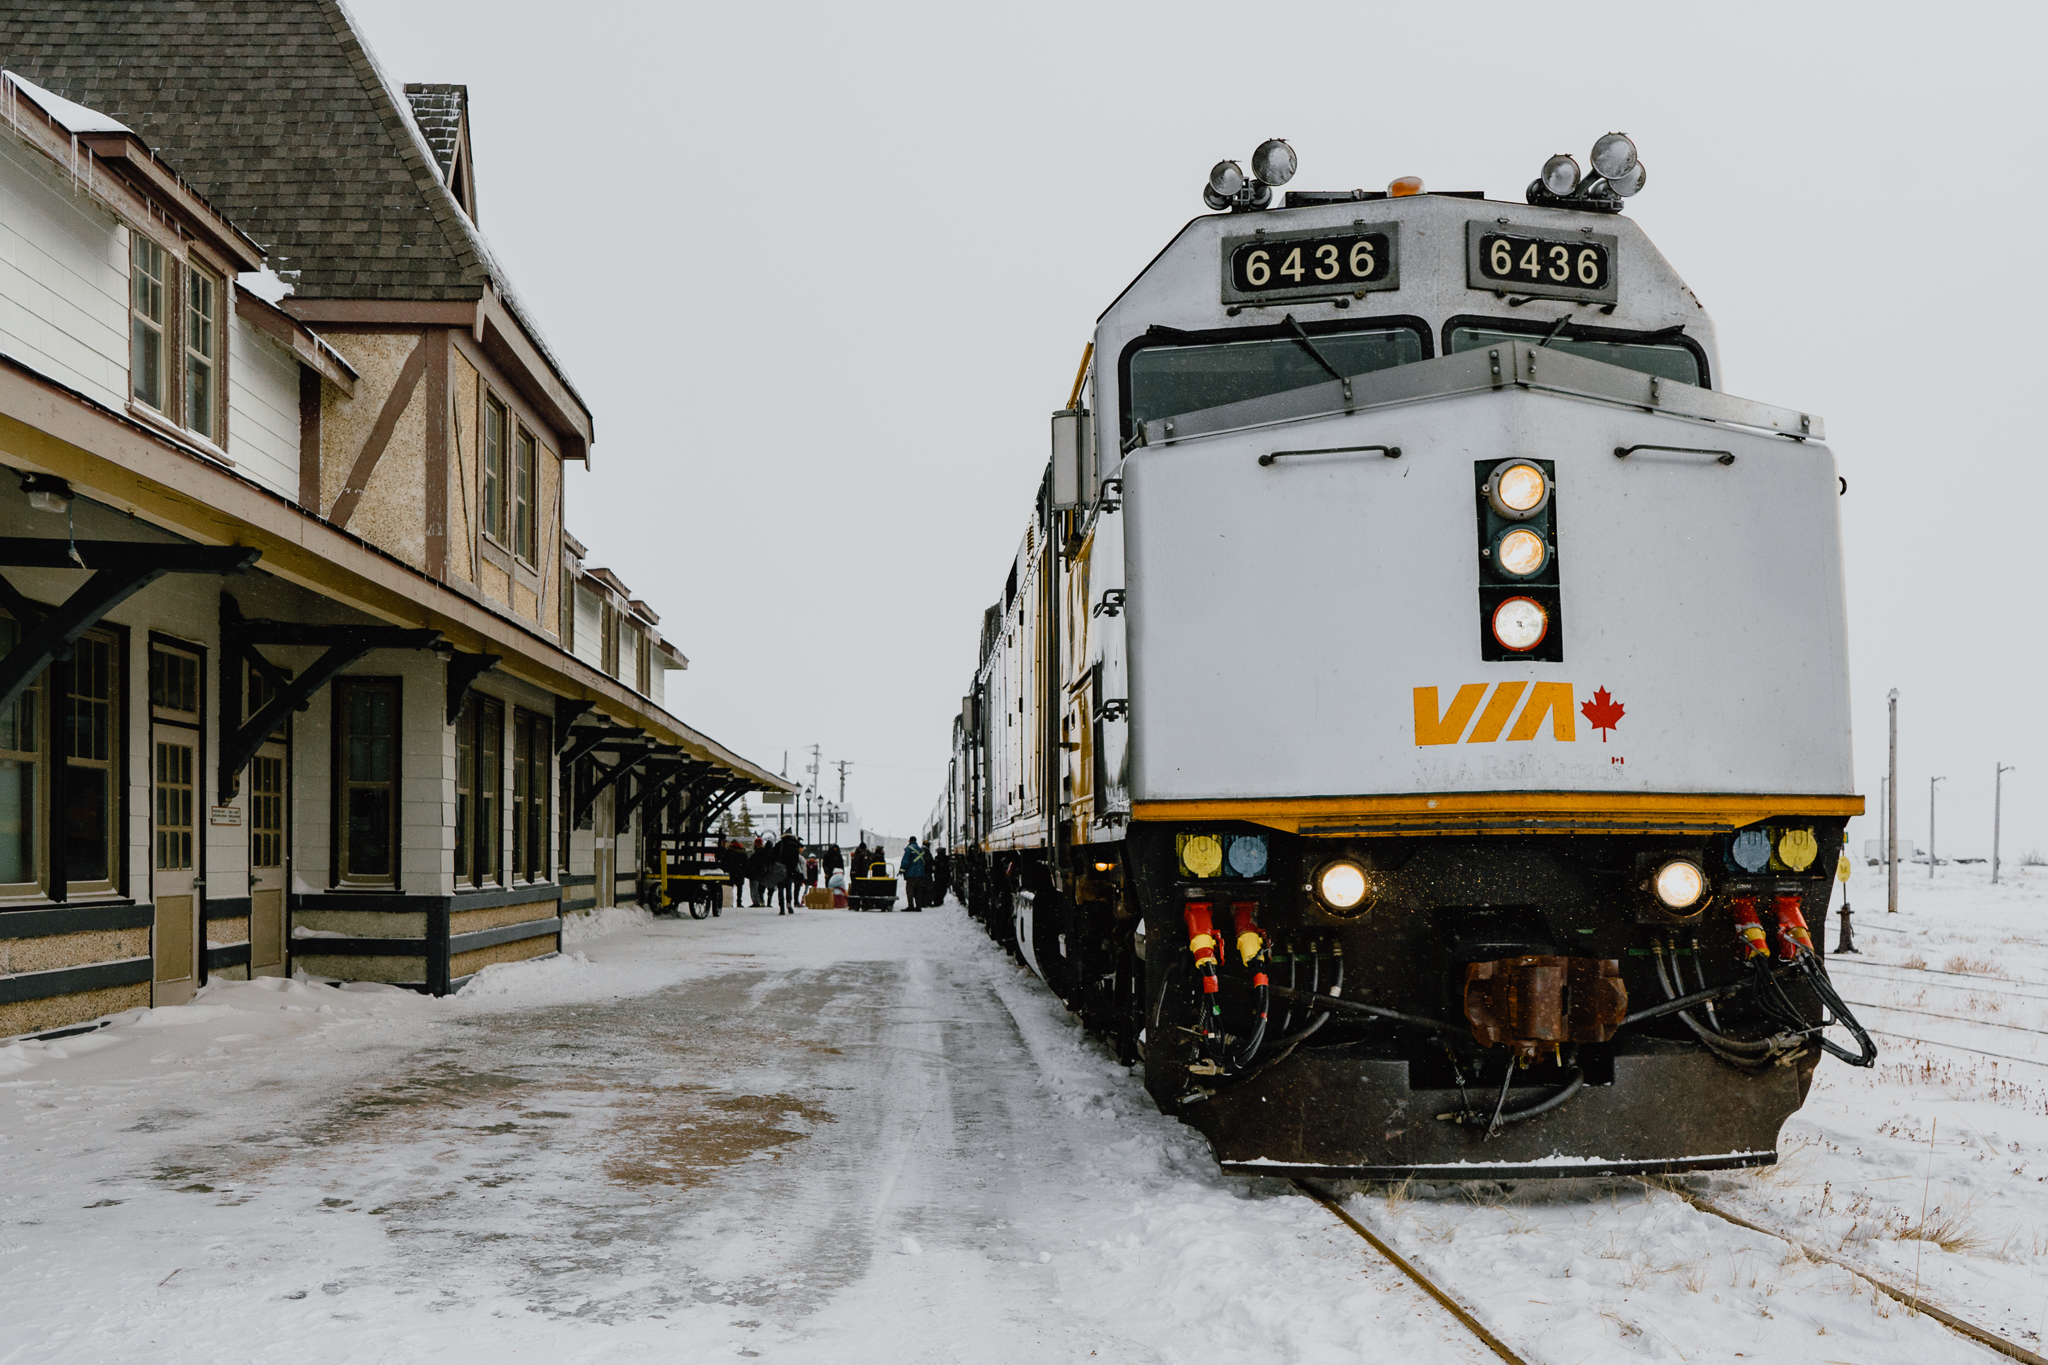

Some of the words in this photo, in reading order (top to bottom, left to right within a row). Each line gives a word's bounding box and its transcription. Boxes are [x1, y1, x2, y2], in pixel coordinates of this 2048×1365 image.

[1246, 241, 1375, 286] 6436
[1490, 239, 1599, 285] 6436
[1413, 681, 1576, 746] VIA
